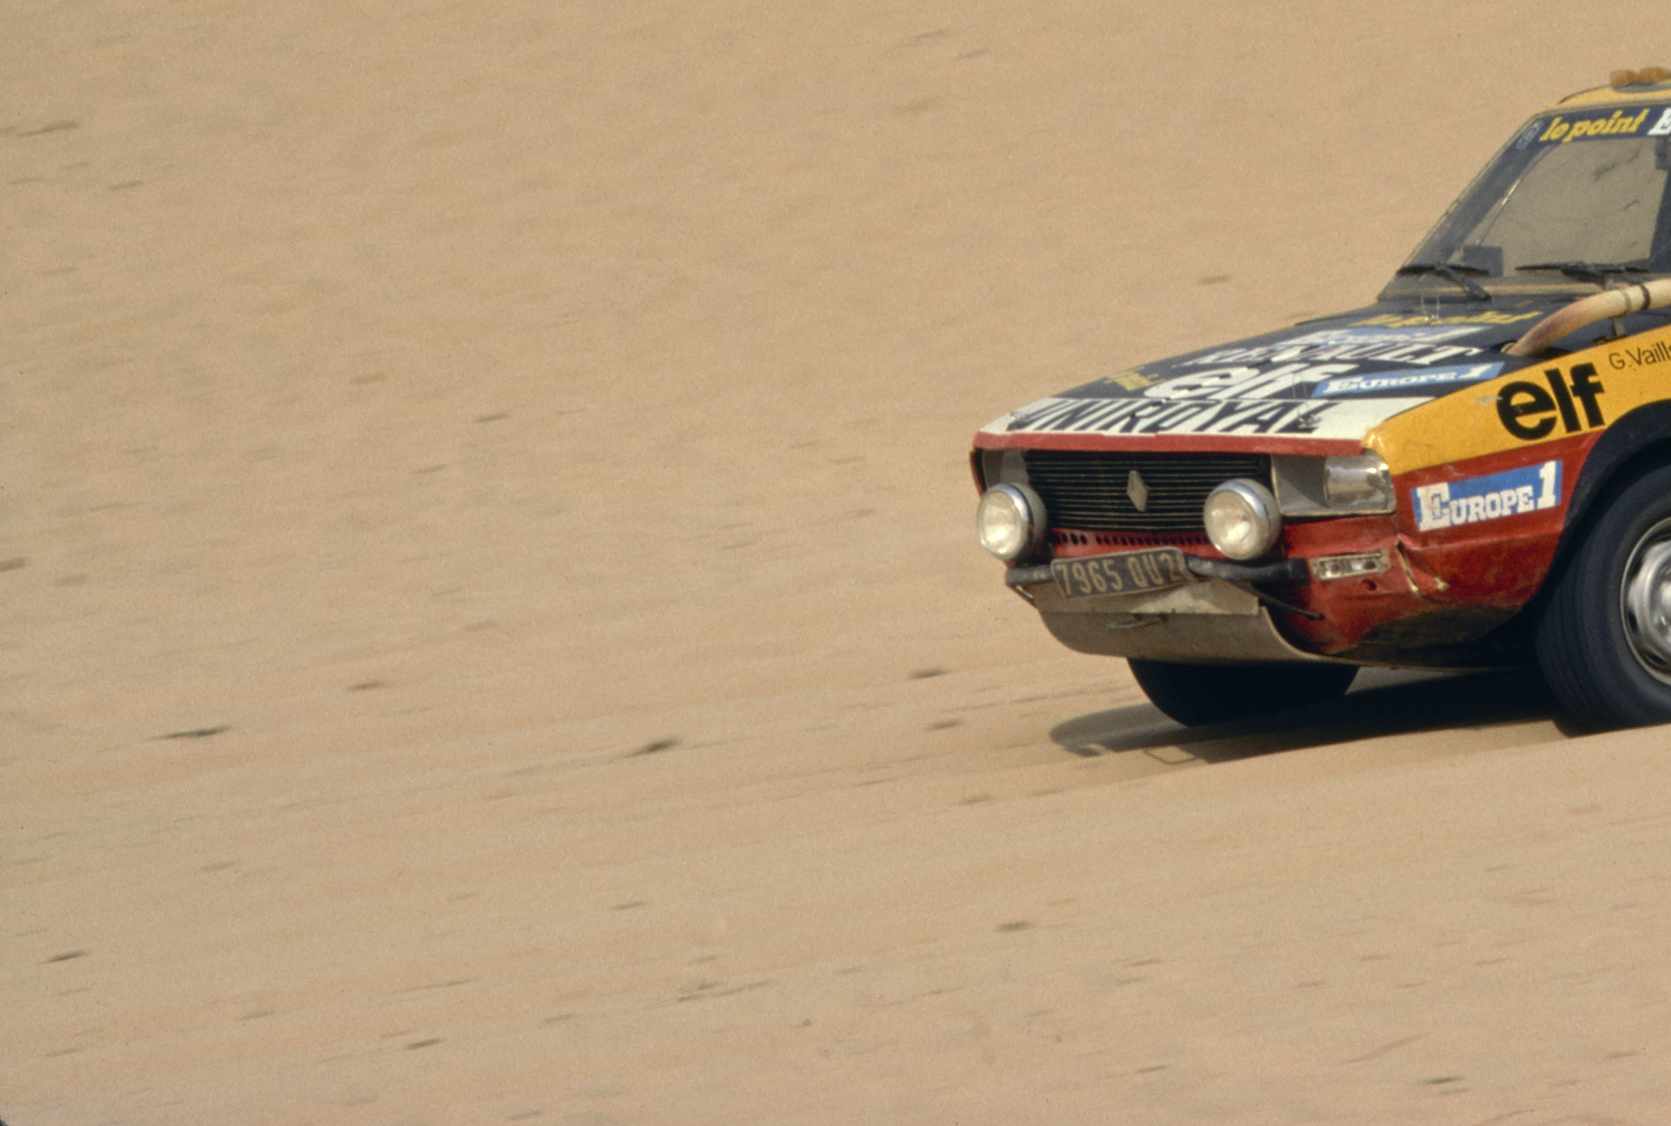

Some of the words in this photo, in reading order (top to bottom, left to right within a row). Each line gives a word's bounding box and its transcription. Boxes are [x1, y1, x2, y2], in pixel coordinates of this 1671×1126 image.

[1539, 117, 1570, 142] le
[1562, 108, 1650, 143] point
[1497, 363, 1604, 440] elf
[1537, 460, 1558, 509] 1
[1056, 558, 1123, 595] 7965
